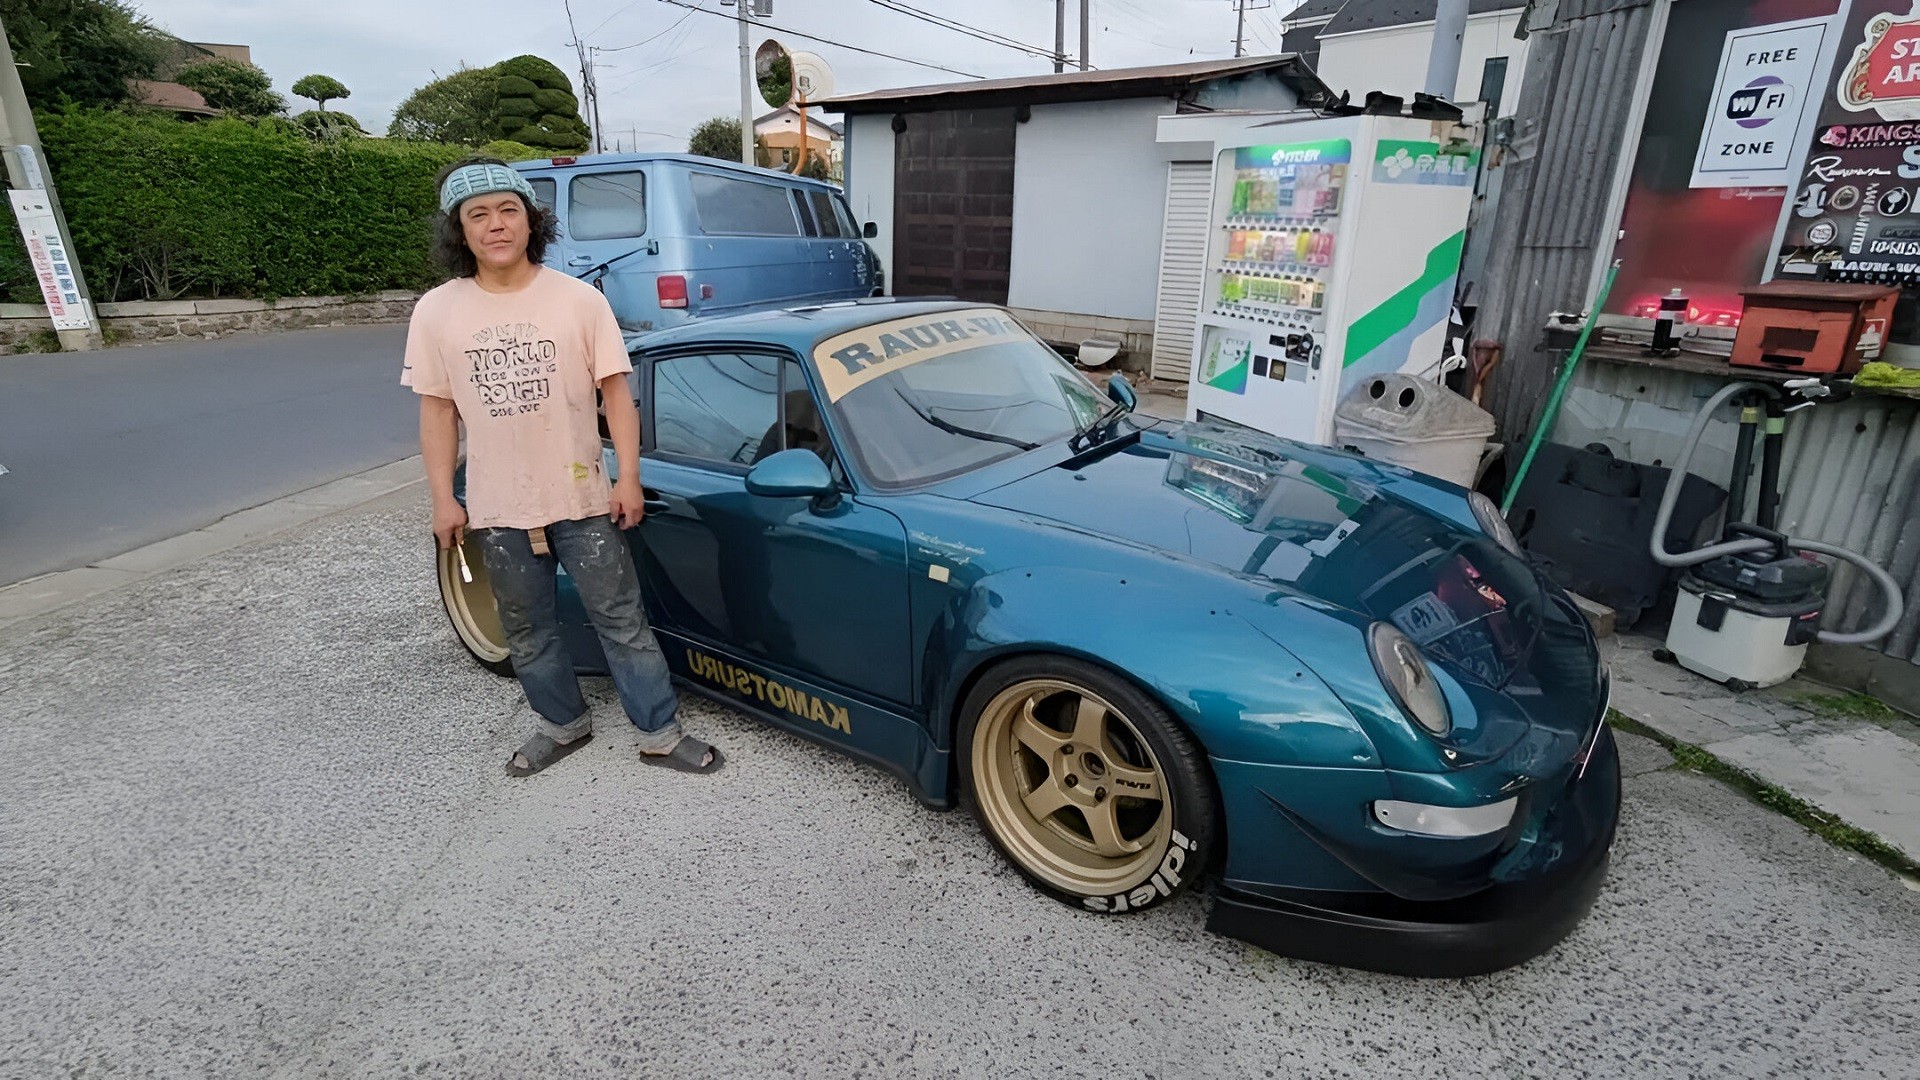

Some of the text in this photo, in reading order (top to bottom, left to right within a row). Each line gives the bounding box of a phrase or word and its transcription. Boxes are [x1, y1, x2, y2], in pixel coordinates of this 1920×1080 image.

[1746, 48, 1798, 66] FREE
[1720, 141, 1774, 155] ZONE
[830, 317, 1016, 376] RAUH-W
[1082, 829, 1198, 913] idlers
